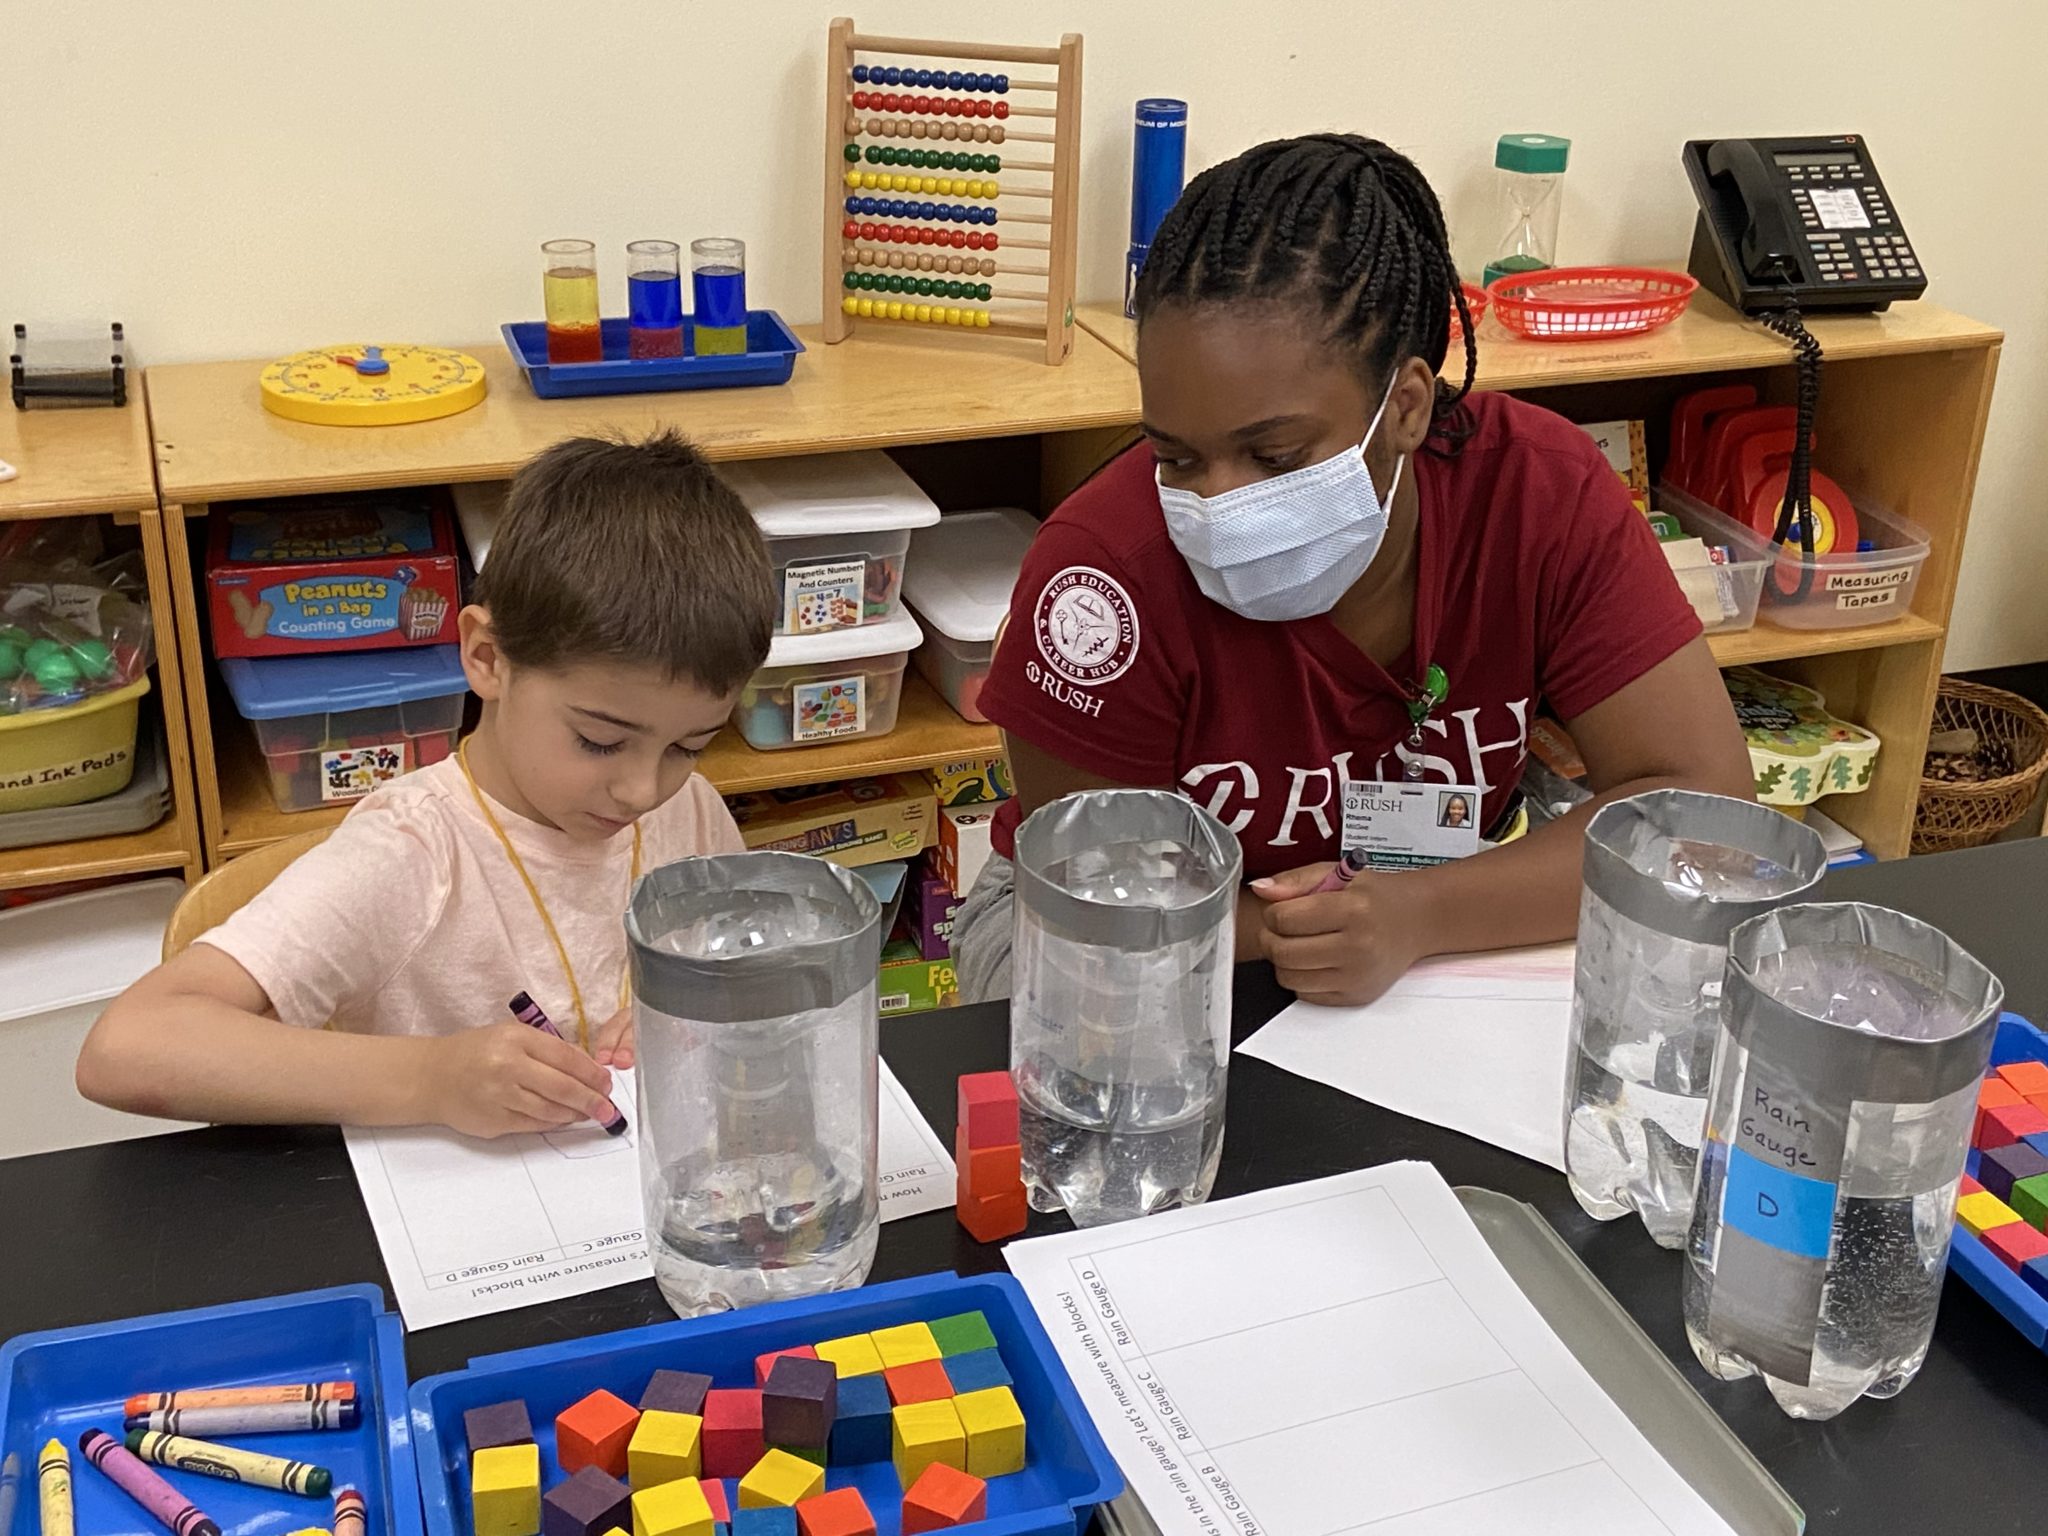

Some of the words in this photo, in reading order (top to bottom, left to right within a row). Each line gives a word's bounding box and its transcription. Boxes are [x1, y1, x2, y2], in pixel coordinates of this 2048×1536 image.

[787, 568, 826, 579] Magnetic
[827, 564, 864, 575] Numbers
[1831, 570, 1908, 588] Measuring
[799, 580, 815, 588] And
[817, 577, 853, 587] Counters
[284, 582, 387, 603] Peanuts
[1842, 593, 1889, 607] Tapes
[303, 603, 319, 616] in
[324, 604, 334, 615] a
[339, 602, 371, 616] Bag
[1049, 575, 1077, 599] RUSH
[1080, 575, 1132, 644] EDUCATION
[279, 619, 346, 634] Counting
[351, 617, 396, 628] Game
[1042, 635, 1085, 677] CAREER
[1090, 659, 1119, 677] HUB
[1041, 672, 1104, 718] RUSH
[802, 729, 832, 740] Healthy
[834, 726, 857, 735] Foods
[39, 766, 76, 783] Ink
[82, 751, 126, 772] Pads
[332, 788, 369, 797] Wooden
[1361, 799, 1402, 812] RUSH
[765, 837, 807, 850] EERING
[1372, 854, 1410, 864] University
[1411, 856, 1440, 864] Medical
[1755, 1087, 1810, 1133] Rain
[1741, 1119, 1816, 1166] Gauge
[896, 1168, 927, 1179] Rain
[892, 1187, 923, 1198] How
[1758, 1192, 1779, 1217] D
[583, 1243, 593, 1252] C
[596, 1232, 642, 1248] Gauge
[513, 1253, 545, 1268] Rain
[629, 1250, 649, 1260] t's
[461, 1262, 509, 1278] Gauge
[564, 1256, 626, 1275] measure
[446, 1273, 458, 1282] D
[528, 1270, 561, 1283] with
[1082, 1270, 1096, 1280] D
[471, 1279, 524, 1298] blocks!
[1090, 1282, 1115, 1319] Gauge
[1056, 1291, 1087, 1333] blocks!
[1111, 1320, 1131, 1346] Rain
[1080, 1334, 1102, 1360] with
[1097, 1361, 1131, 1407] measure
[1138, 1371, 1151, 1381] C
[1147, 1382, 1174, 1416] Gauge
[1124, 1408, 1148, 1434] Let's
[1170, 1416, 1192, 1441] Rain
[1140, 1435, 1178, 1471] gauge?
[1201, 1466, 1215, 1475] B
[1169, 1472, 1191, 1494] rain
[1210, 1476, 1240, 1511] Gauge
[1185, 1495, 1204, 1514] the
[1199, 1515, 1214, 1528] in
[1236, 1511, 1260, 1536] Rain
